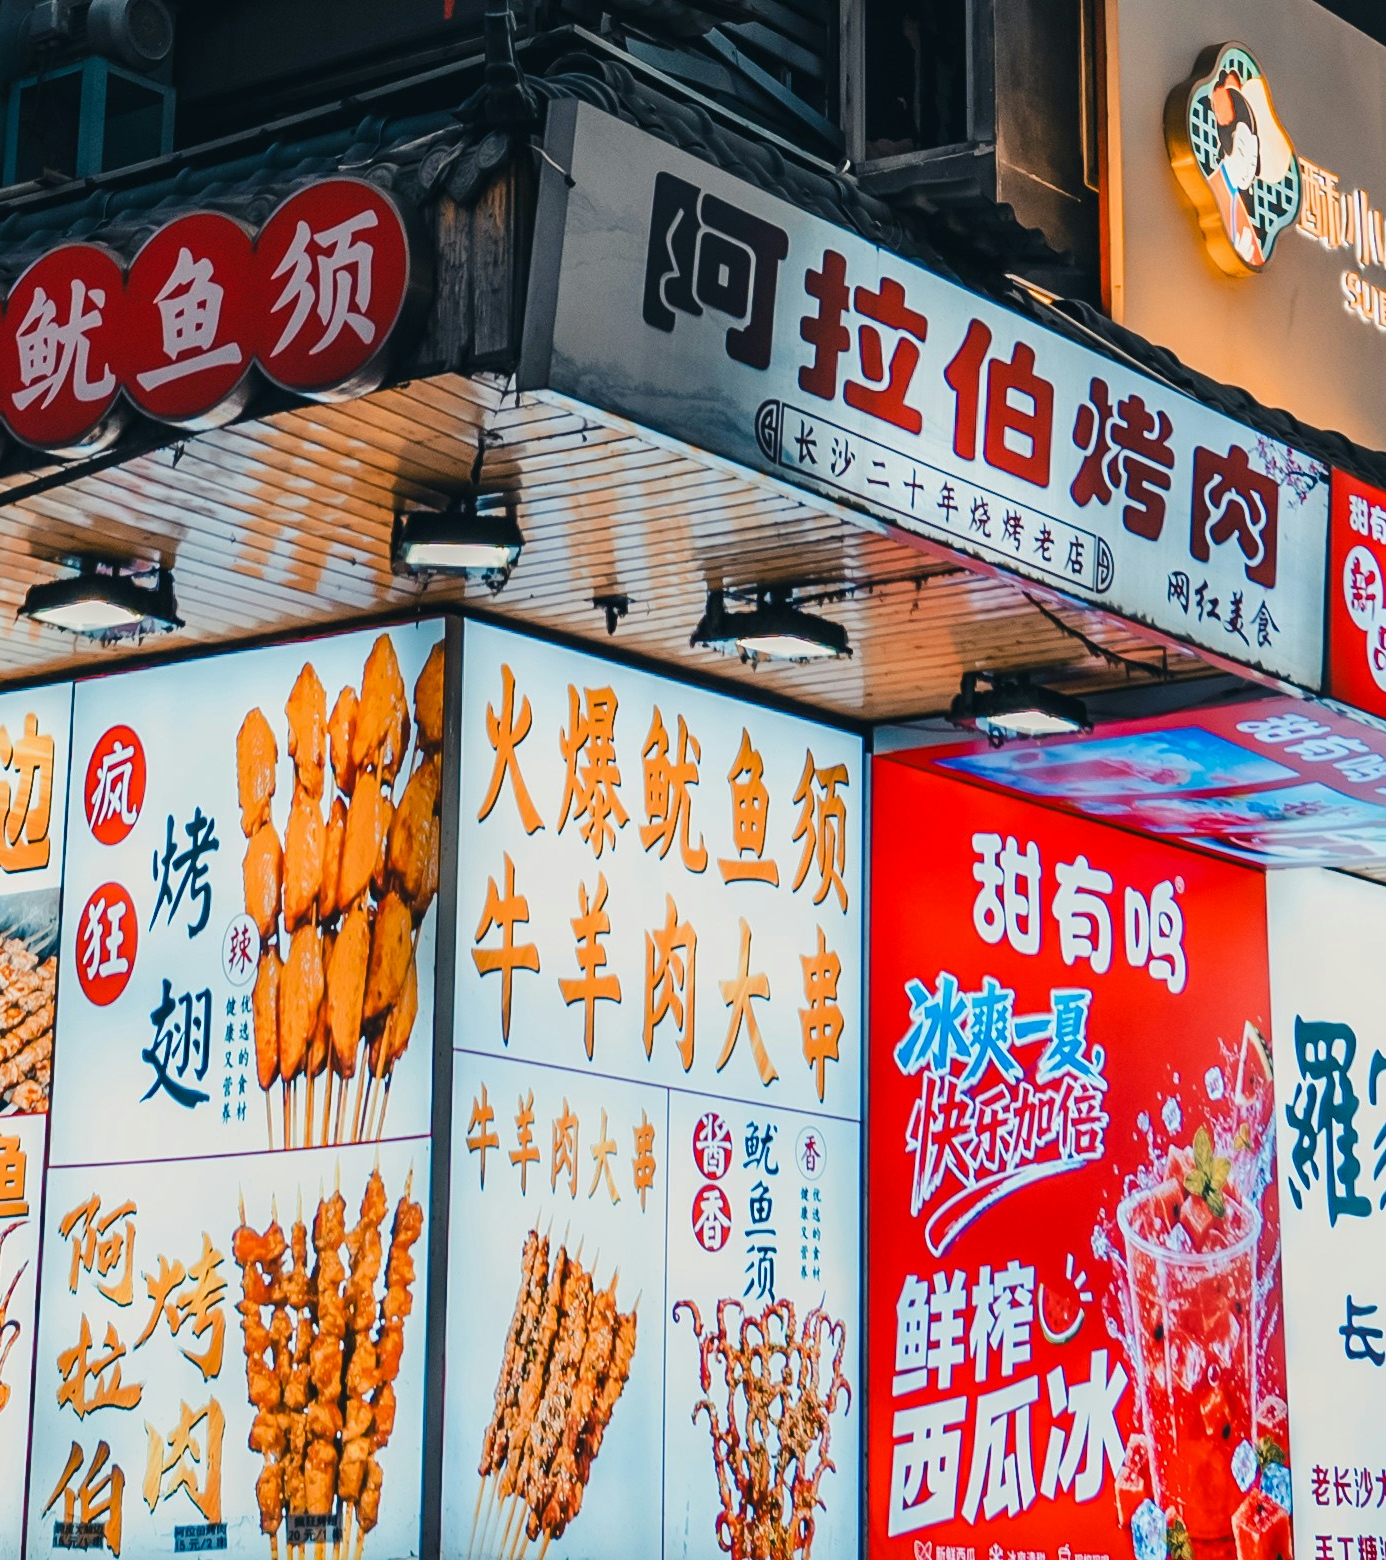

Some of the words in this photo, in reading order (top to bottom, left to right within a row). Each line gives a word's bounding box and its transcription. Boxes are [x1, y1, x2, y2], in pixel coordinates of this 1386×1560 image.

[644, 171, 1281, 586] 阿拉伯烤肉
[794, 430, 1088, 578] 长沙二十年烧烤老店
[1166, 566, 1280, 649] 网红美食
[84, 739, 140, 979] 疯狂
[477, 662, 849, 914] 火爆鱿鱼须
[140, 807, 219, 1109] 烤翅
[229, 924, 253, 974] 辣
[472, 851, 845, 1104] 牛羊肉大串
[973, 832, 1188, 993] 甜有鸣
[467, 1081, 656, 1212] 牛羊肉大串
[695, 1120, 731, 1245] 酱香
[743, 1120, 779, 1301] 鱿鱼须
[799, 1134, 823, 1173] 香
[41, 1195, 143, 1557] 阿拉伯
[134, 1231, 228, 1525] 烤肉
[895, 1257, 1033, 1397] 鲜榨
[888, 1349, 1129, 1537] 西瓜冰
